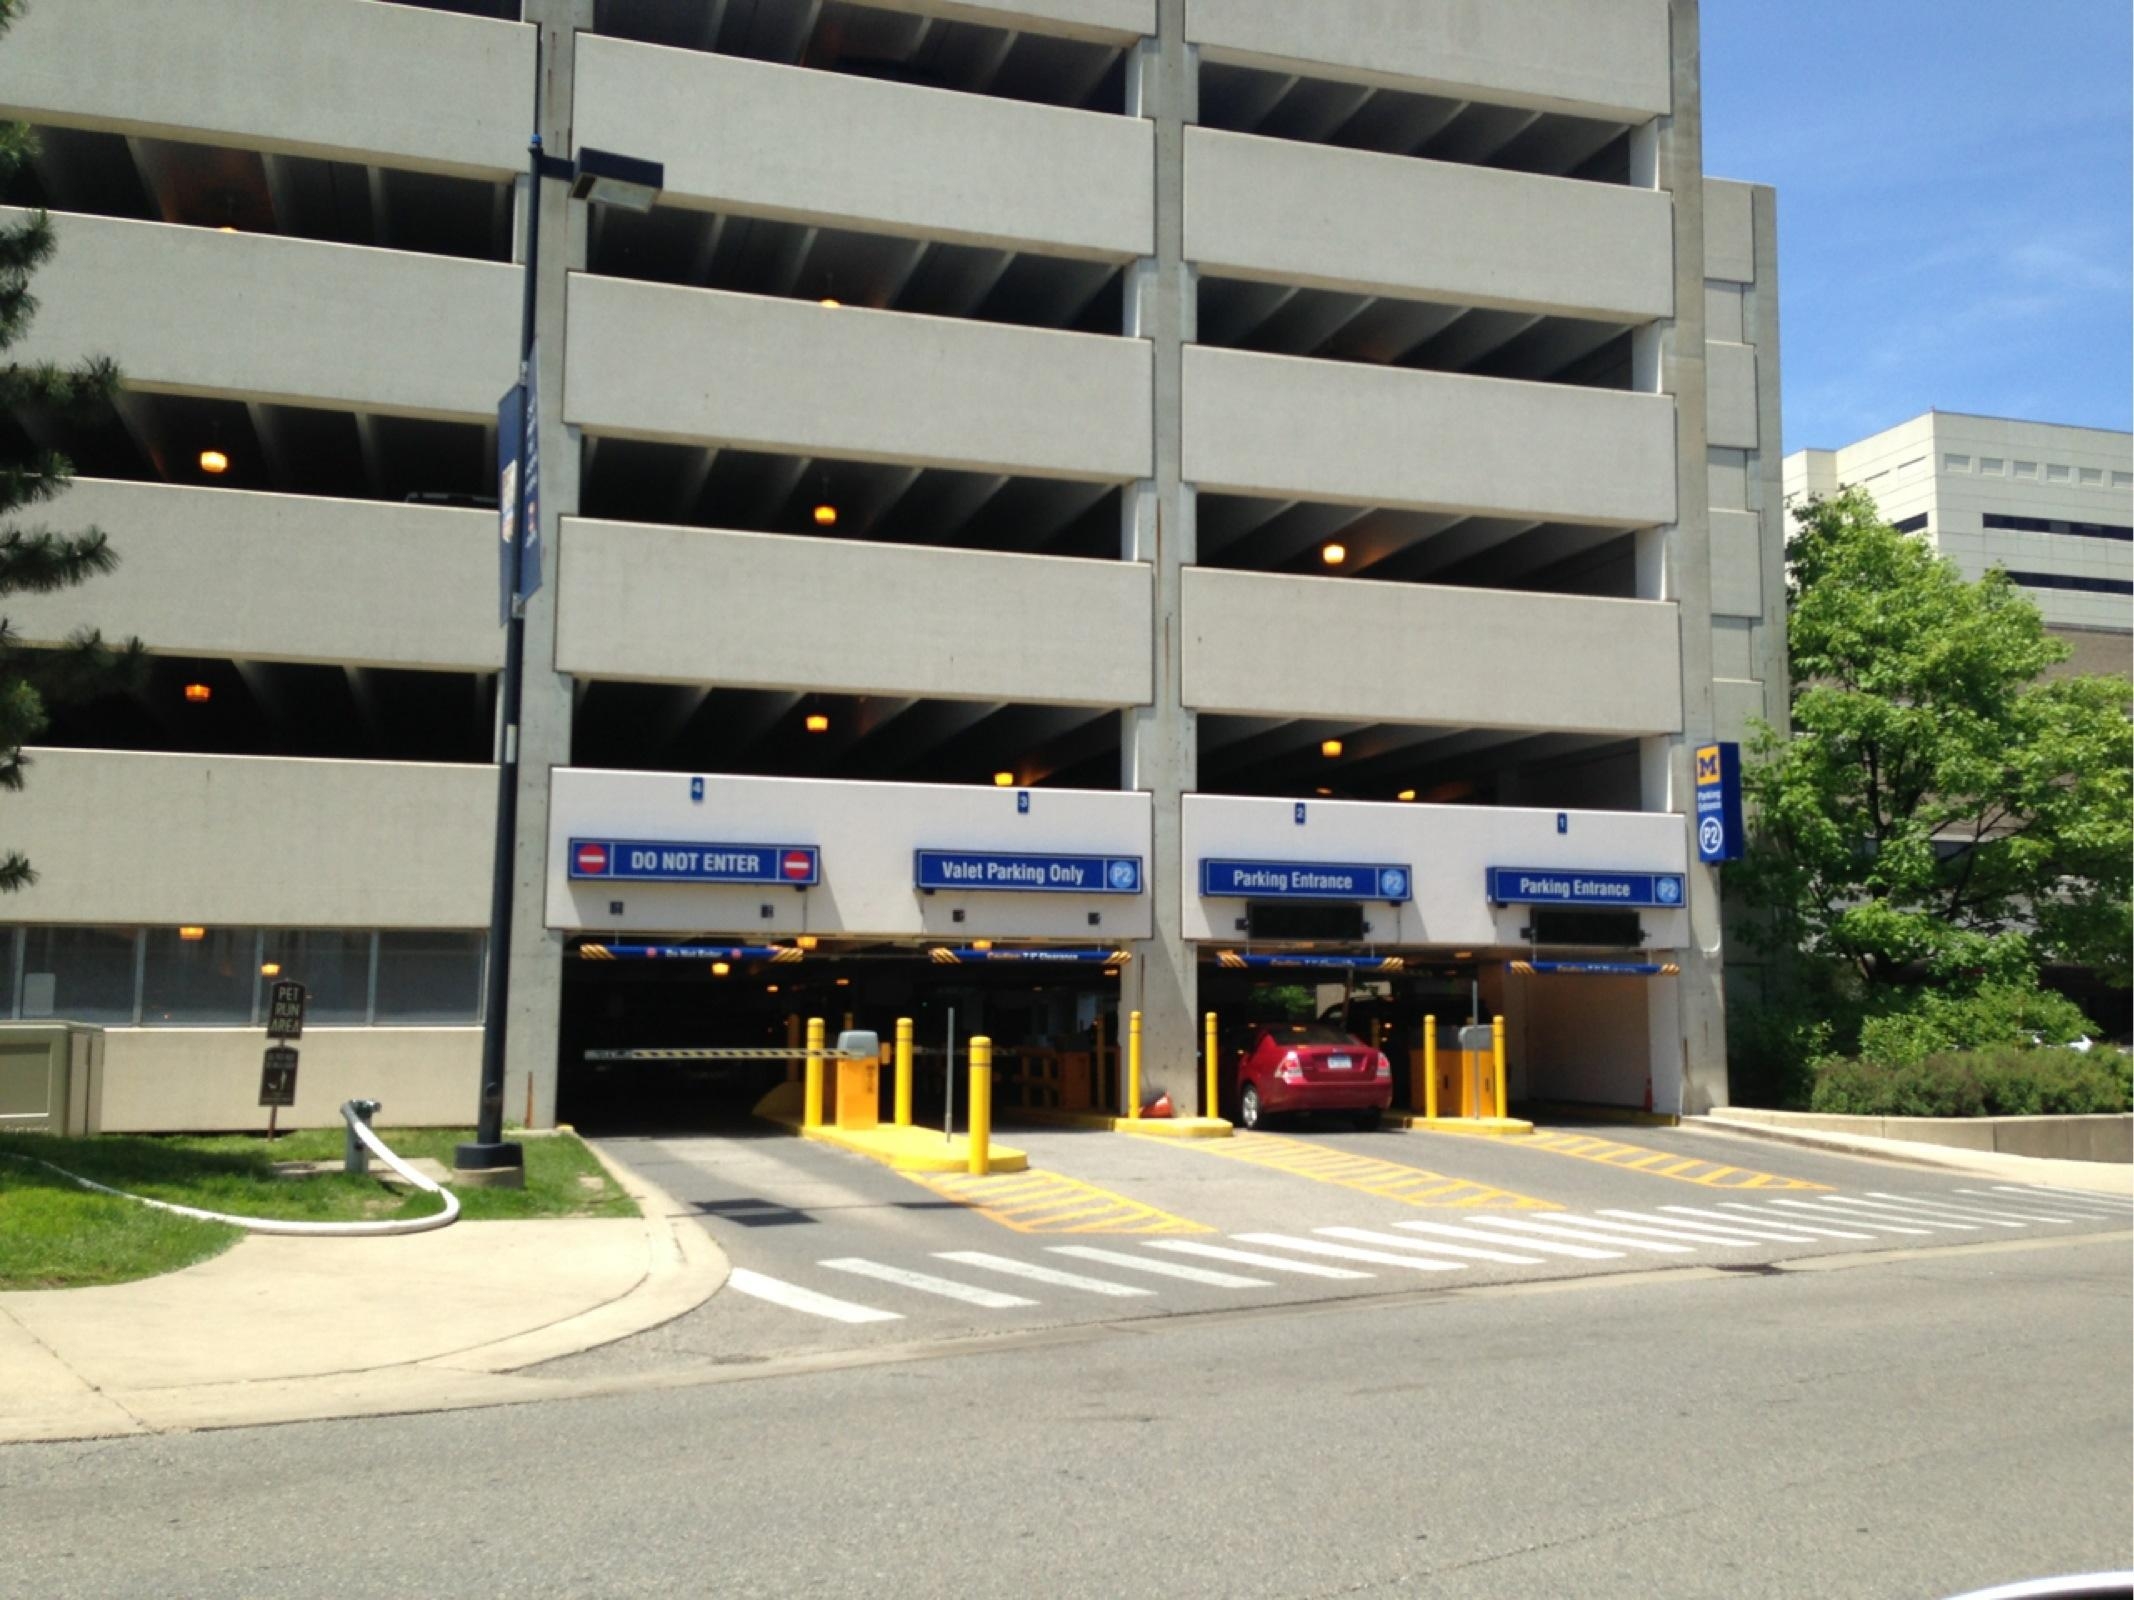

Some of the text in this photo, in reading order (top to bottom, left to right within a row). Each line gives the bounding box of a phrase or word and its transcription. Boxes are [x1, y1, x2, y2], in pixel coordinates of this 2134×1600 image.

[1698, 754, 1717, 778] M
[1704, 826, 1719, 845] P2
[631, 851, 760, 873] DO NOT ENTER
[942, 861, 1084, 885] Valet Parking Only
[1112, 866, 1132, 883] P2
[1232, 869, 1353, 891] Parking Entrance
[1385, 876, 1401, 890] P2
[1520, 878, 1631, 898] Parking Entrance
[1659, 883, 1676, 897] P2
[279, 986, 299, 1001] PET
[275, 1001, 300, 1017] RUN
[271, 1017, 300, 1033] AREA
